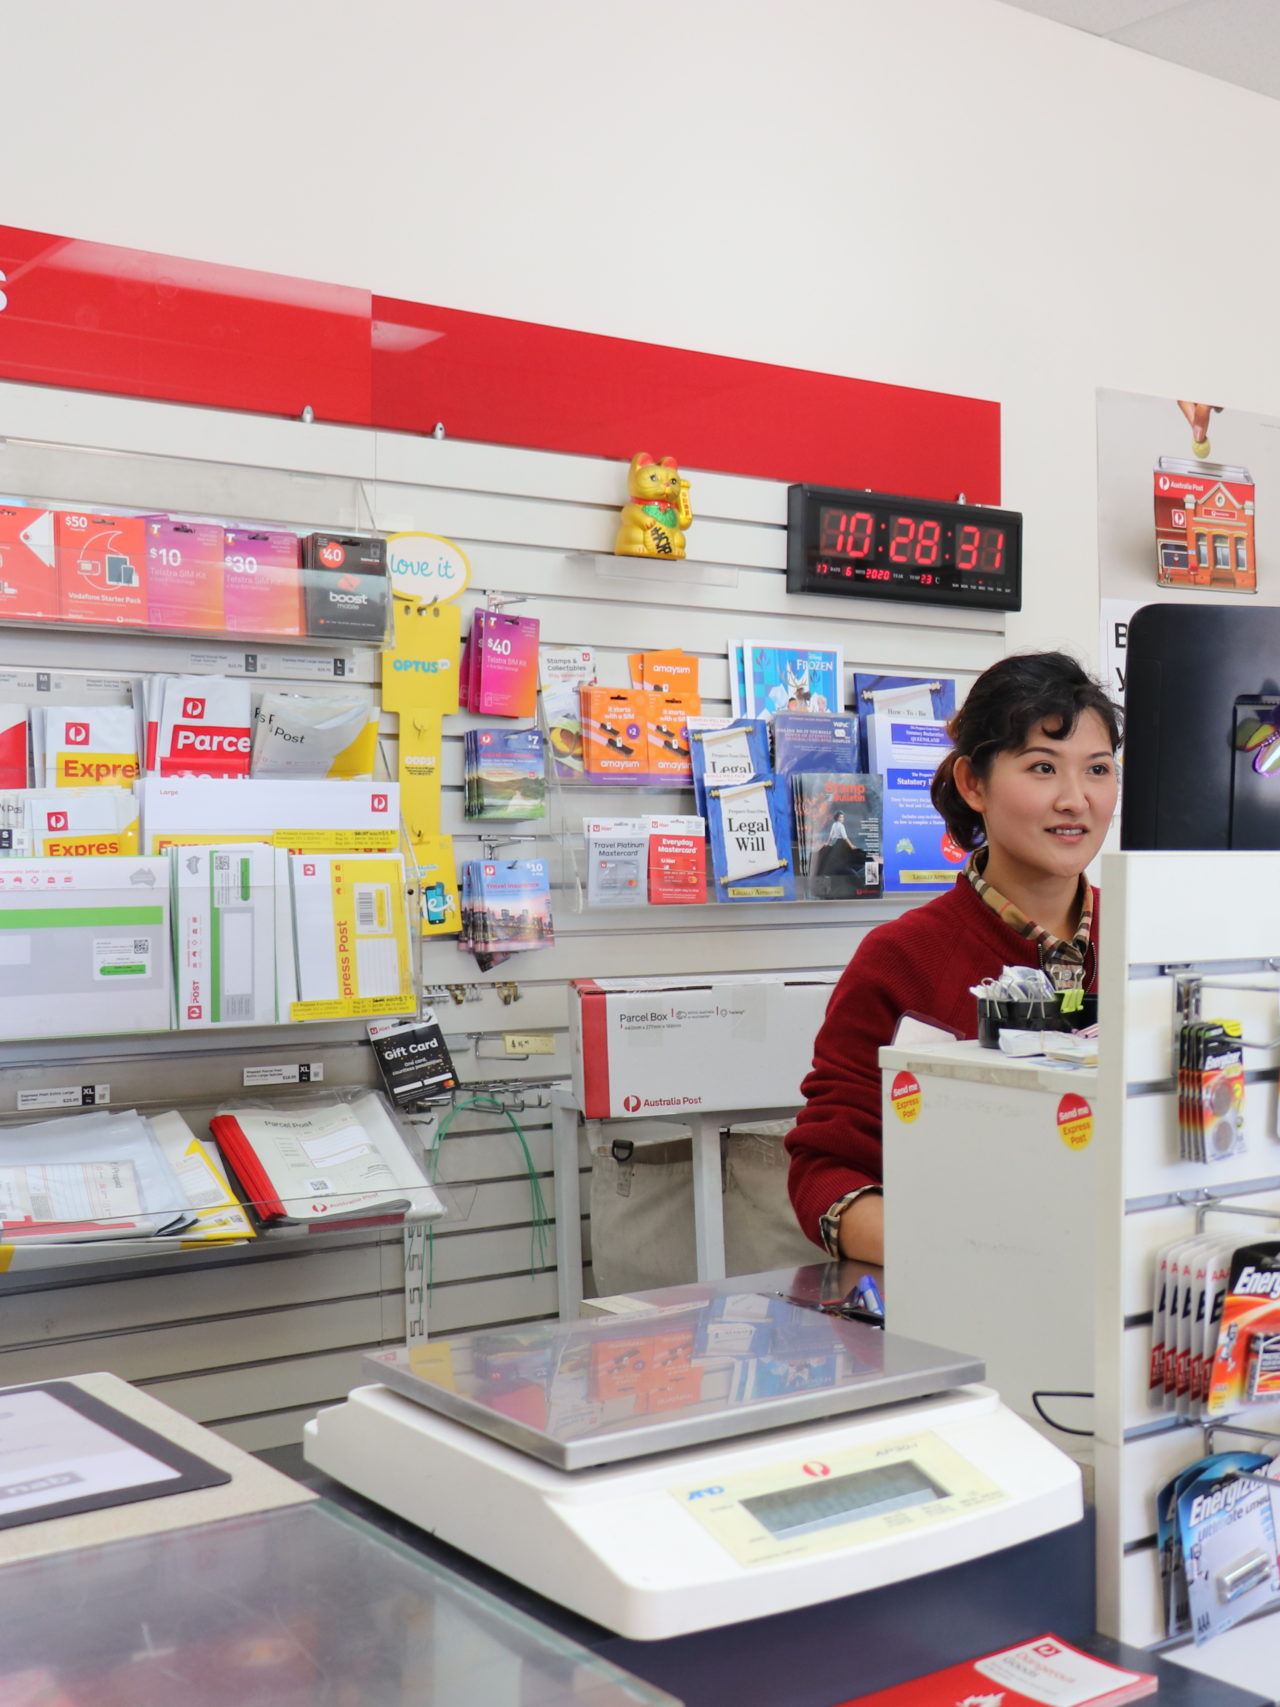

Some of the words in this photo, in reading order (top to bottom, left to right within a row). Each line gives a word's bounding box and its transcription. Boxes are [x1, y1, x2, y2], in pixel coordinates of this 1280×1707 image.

[1170, 480, 1192, 491] Australia
[65, 516, 88, 528] $50
[149, 547, 181, 566] $10
[322, 549, 342, 562] $40
[225, 556, 258, 573] $30
[390, 553, 432, 577] love
[438, 557, 455, 579] it
[226, 574, 253, 584] Telstra
[865, 568, 891, 580] 2020
[329, 591, 367, 605] boost
[487, 638, 511, 656] $40
[393, 659, 439, 673] OPTUS
[547, 658, 573, 666] Stamps
[797, 659, 833, 672] FROZEN
[653, 664, 691, 674] amaysim
[177, 731, 251, 752] Parce
[274, 726, 305, 744] Post
[528, 735, 539, 745] $7
[600, 760, 639, 771] amaysim
[825, 782, 866, 795] Stamp
[897, 778, 926, 787] Statutory
[728, 818, 770, 835] Legal
[735, 837, 766, 852] Will
[336, 921, 348, 953] Post
[620, 1013, 649, 1023] Parcel
[650, 1012, 668, 1022] Box
[384, 1047, 408, 1060] Gift
[409, 1038, 439, 1053] Card
[893, 1085, 907, 1097] Send
[643, 1097, 681, 1108] Australia
[683, 1096, 702, 1105] Post
[896, 1098, 920, 1110] Express
[902, 1108, 916, 1118] Post
[1059, 1108, 1074, 1121] Send
[1076, 1107, 1089, 1117] me
[1063, 1122, 1091, 1136] Express
[1071, 1134, 1087, 1144] Post
